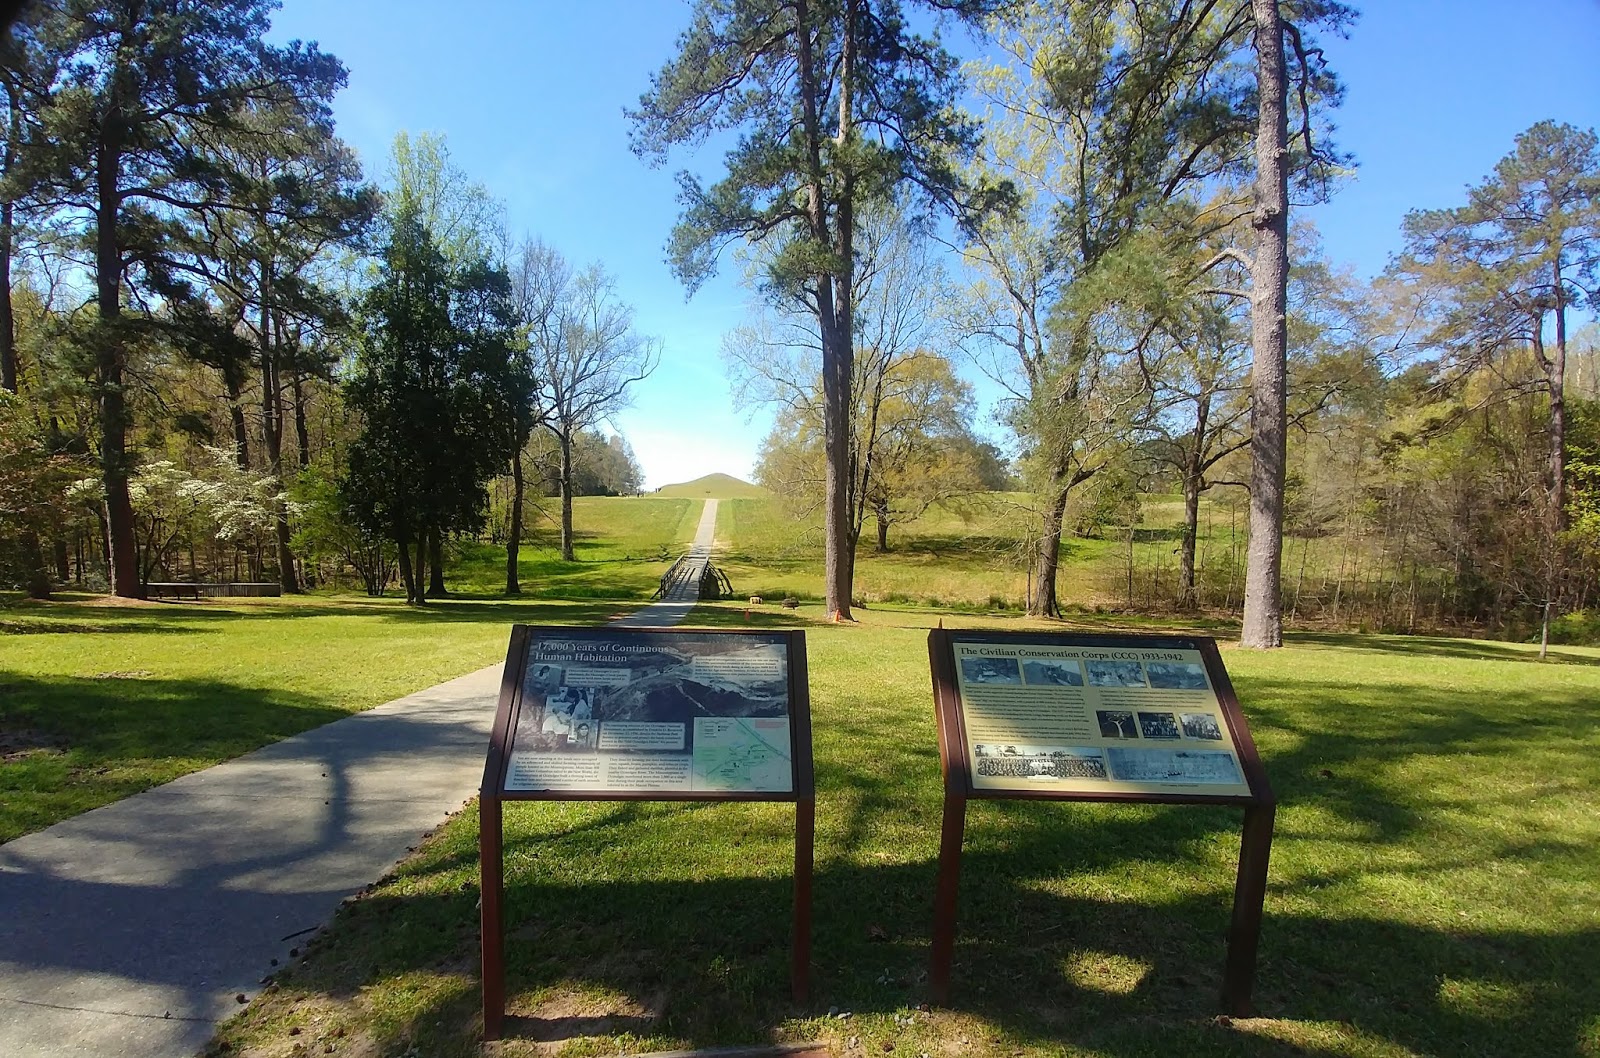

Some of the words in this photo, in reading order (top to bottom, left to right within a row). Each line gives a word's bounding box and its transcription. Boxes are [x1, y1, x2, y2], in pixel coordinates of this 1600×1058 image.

[538, 642, 569, 651] 17,000
[571, 643, 597, 652] Years
[599, 643, 609, 652] of
[612, 643, 669, 653] Continuous
[535, 652, 572, 661] Human
[574, 653, 627, 662] Habitation
[959, 646, 979, 656] The
[980, 647, 1016, 657] Civilian
[1018, 648, 1079, 660] Conservation
[1081, 650, 1109, 662] Corps
[1111, 650, 1139, 662] (CCC)
[1141, 652, 1184, 661] 1933-1942
